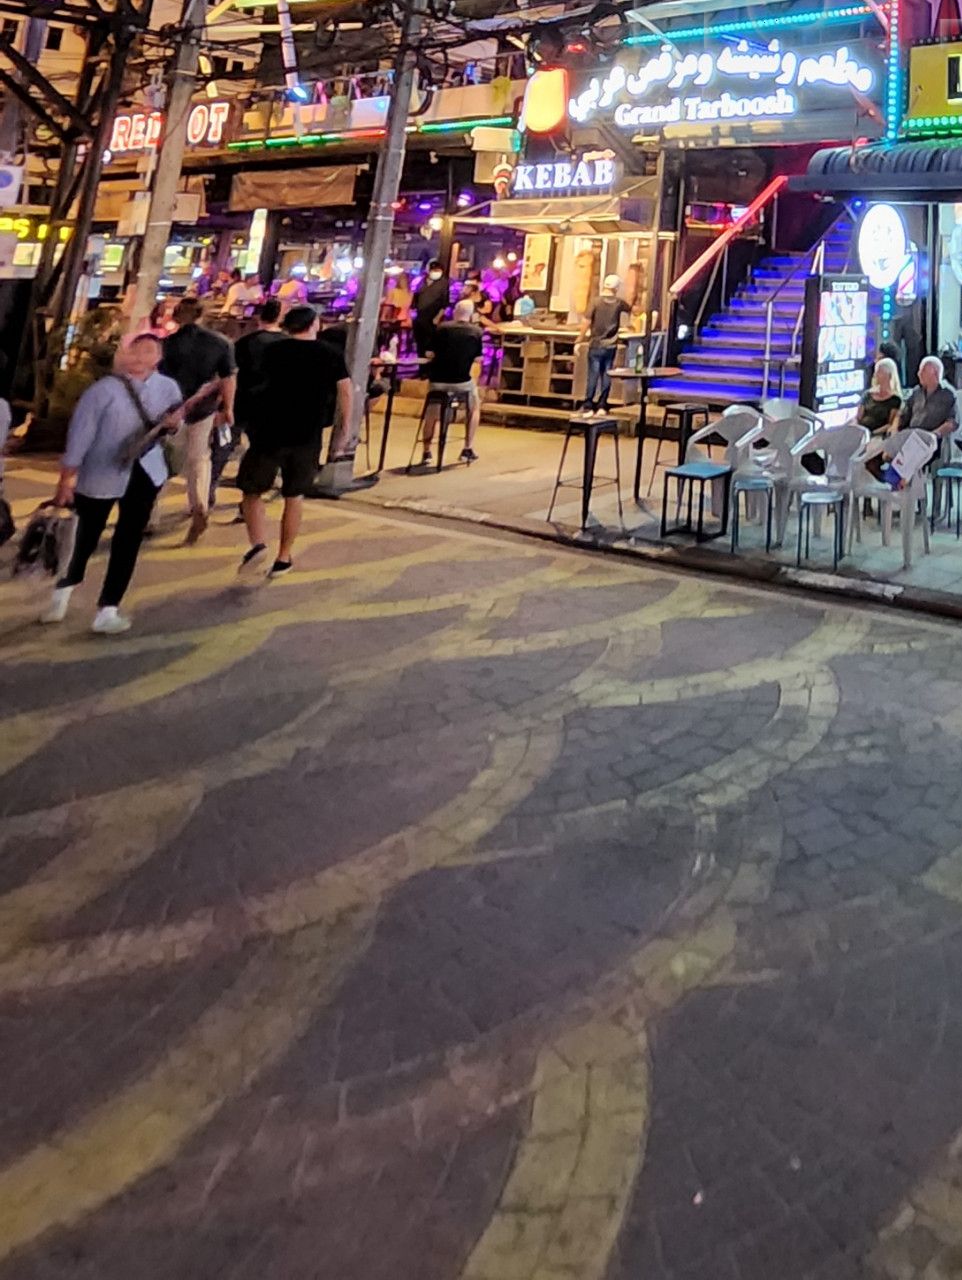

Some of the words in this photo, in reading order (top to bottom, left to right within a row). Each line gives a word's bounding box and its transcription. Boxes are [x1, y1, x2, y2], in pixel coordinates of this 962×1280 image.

[186, 102, 230, 144] OT
[613, 96, 681, 127] Grand
[684, 88, 796, 121] Tarboosh
[513, 159, 615, 191] KEBAB
